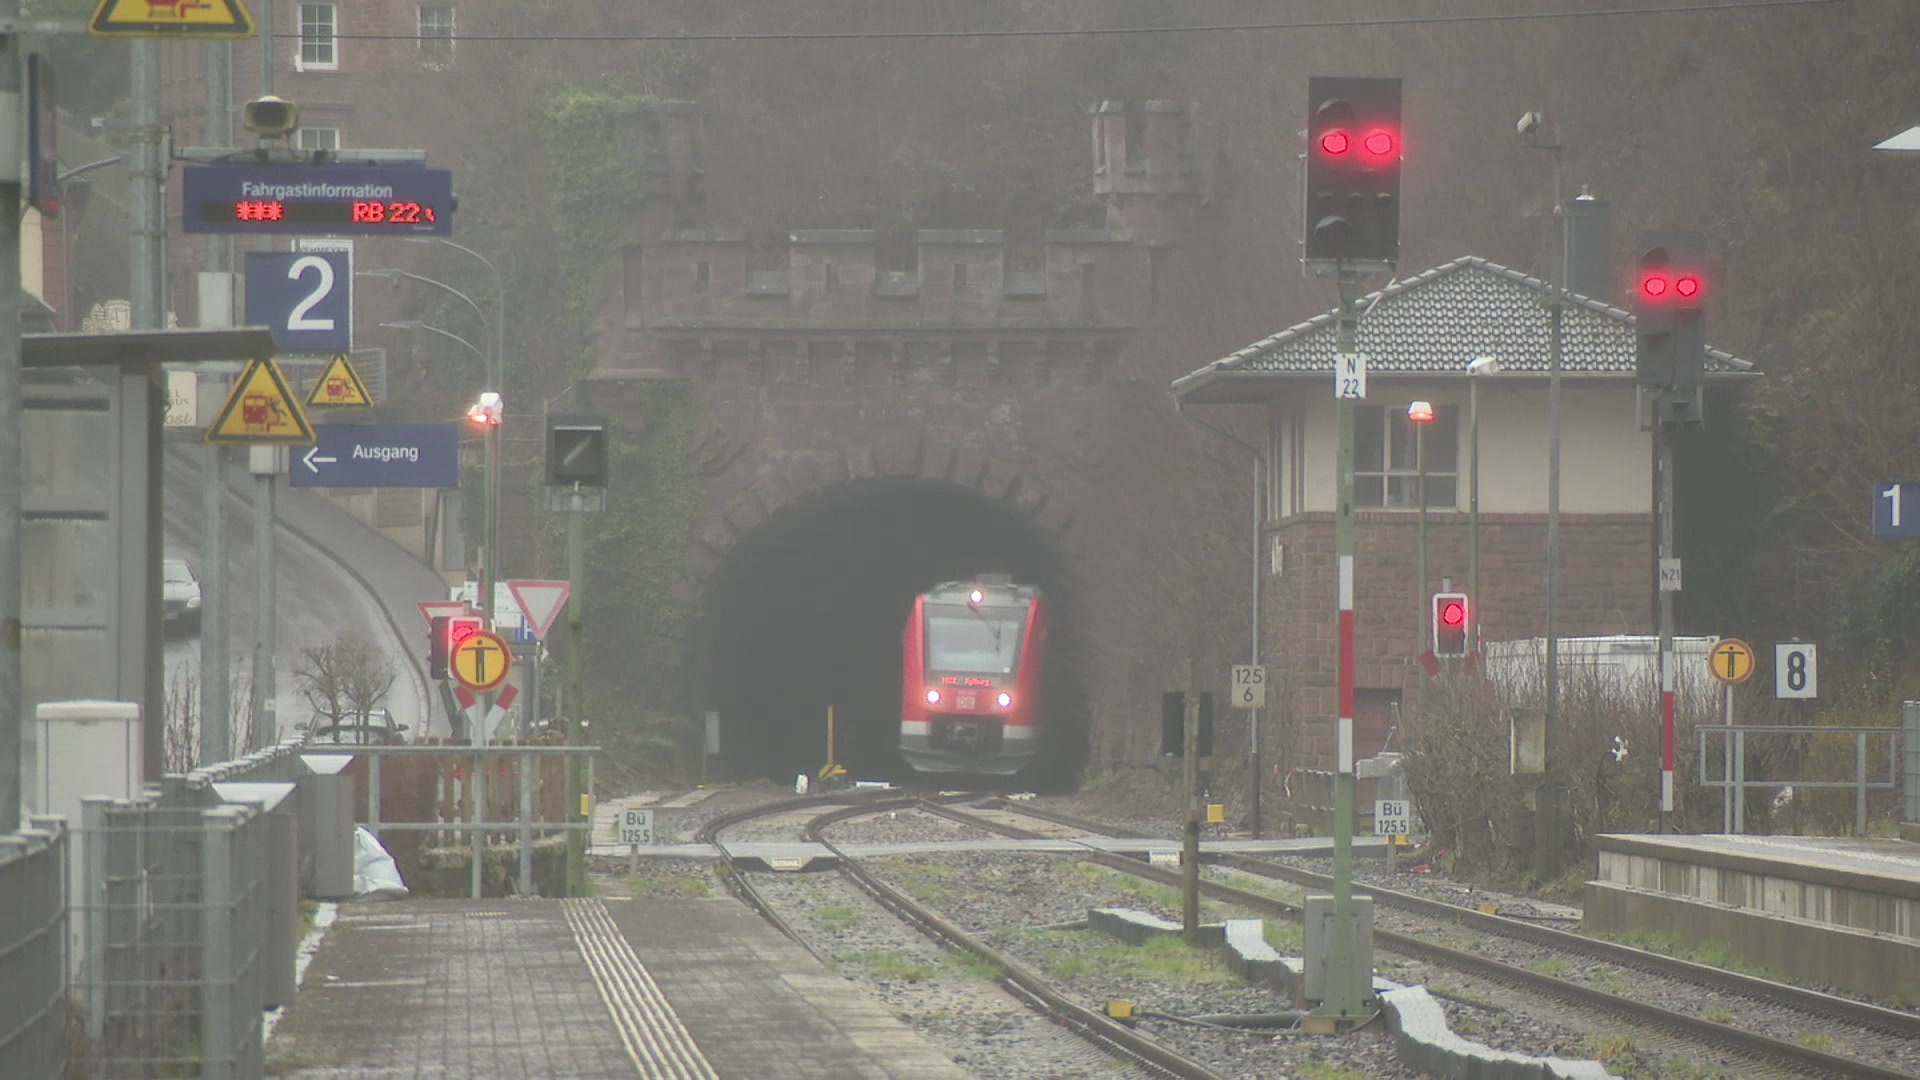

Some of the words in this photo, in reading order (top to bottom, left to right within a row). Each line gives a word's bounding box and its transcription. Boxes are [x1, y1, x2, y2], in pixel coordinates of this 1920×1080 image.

[242, 182, 393, 200] Fahrgastinformation
[352, 201, 385, 222] RB
[388, 201, 420, 222] 22
[287, 255, 334, 330] 2
[1347, 358, 1356, 374] N
[1343, 378, 1359, 395] 22
[352, 444, 419, 463] Ausgang
[1882, 484, 1901, 527] 1
[1235, 668, 1263, 685] 125
[1787, 651, 1806, 692] 8
[1243, 686, 1254, 703] 6
[1383, 802, 1402, 816] Bü
[626, 811, 646, 826] Bü
